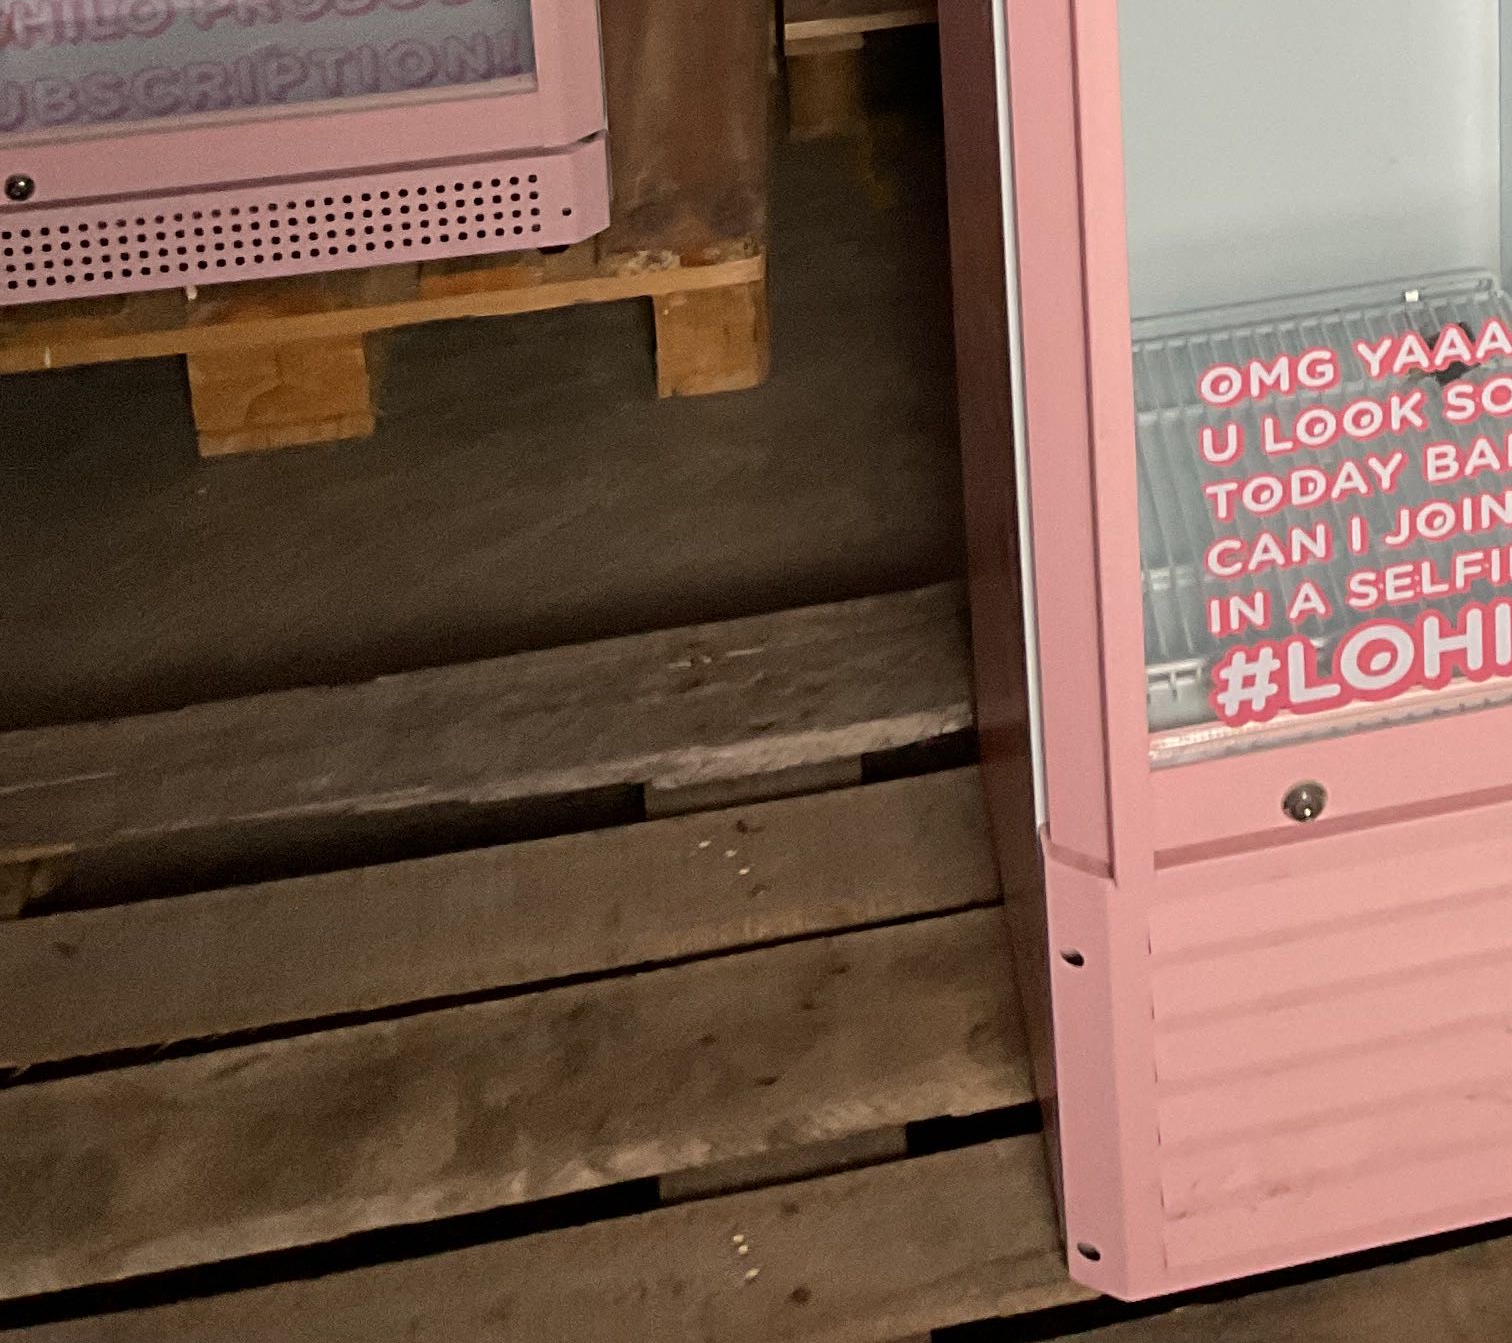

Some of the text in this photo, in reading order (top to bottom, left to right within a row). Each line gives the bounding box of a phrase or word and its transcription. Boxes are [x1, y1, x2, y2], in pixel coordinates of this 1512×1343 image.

[1201, 351, 1335, 403] OMG
[1202, 425, 1239, 463] U
[1264, 391, 1424, 453] LOOK
[1205, 453, 1403, 519] TODAY
[1207, 524, 1327, 577] CAN
[1351, 516, 1364, 554] I
[1208, 591, 1266, 634] IN
[1289, 582, 1327, 620] A
